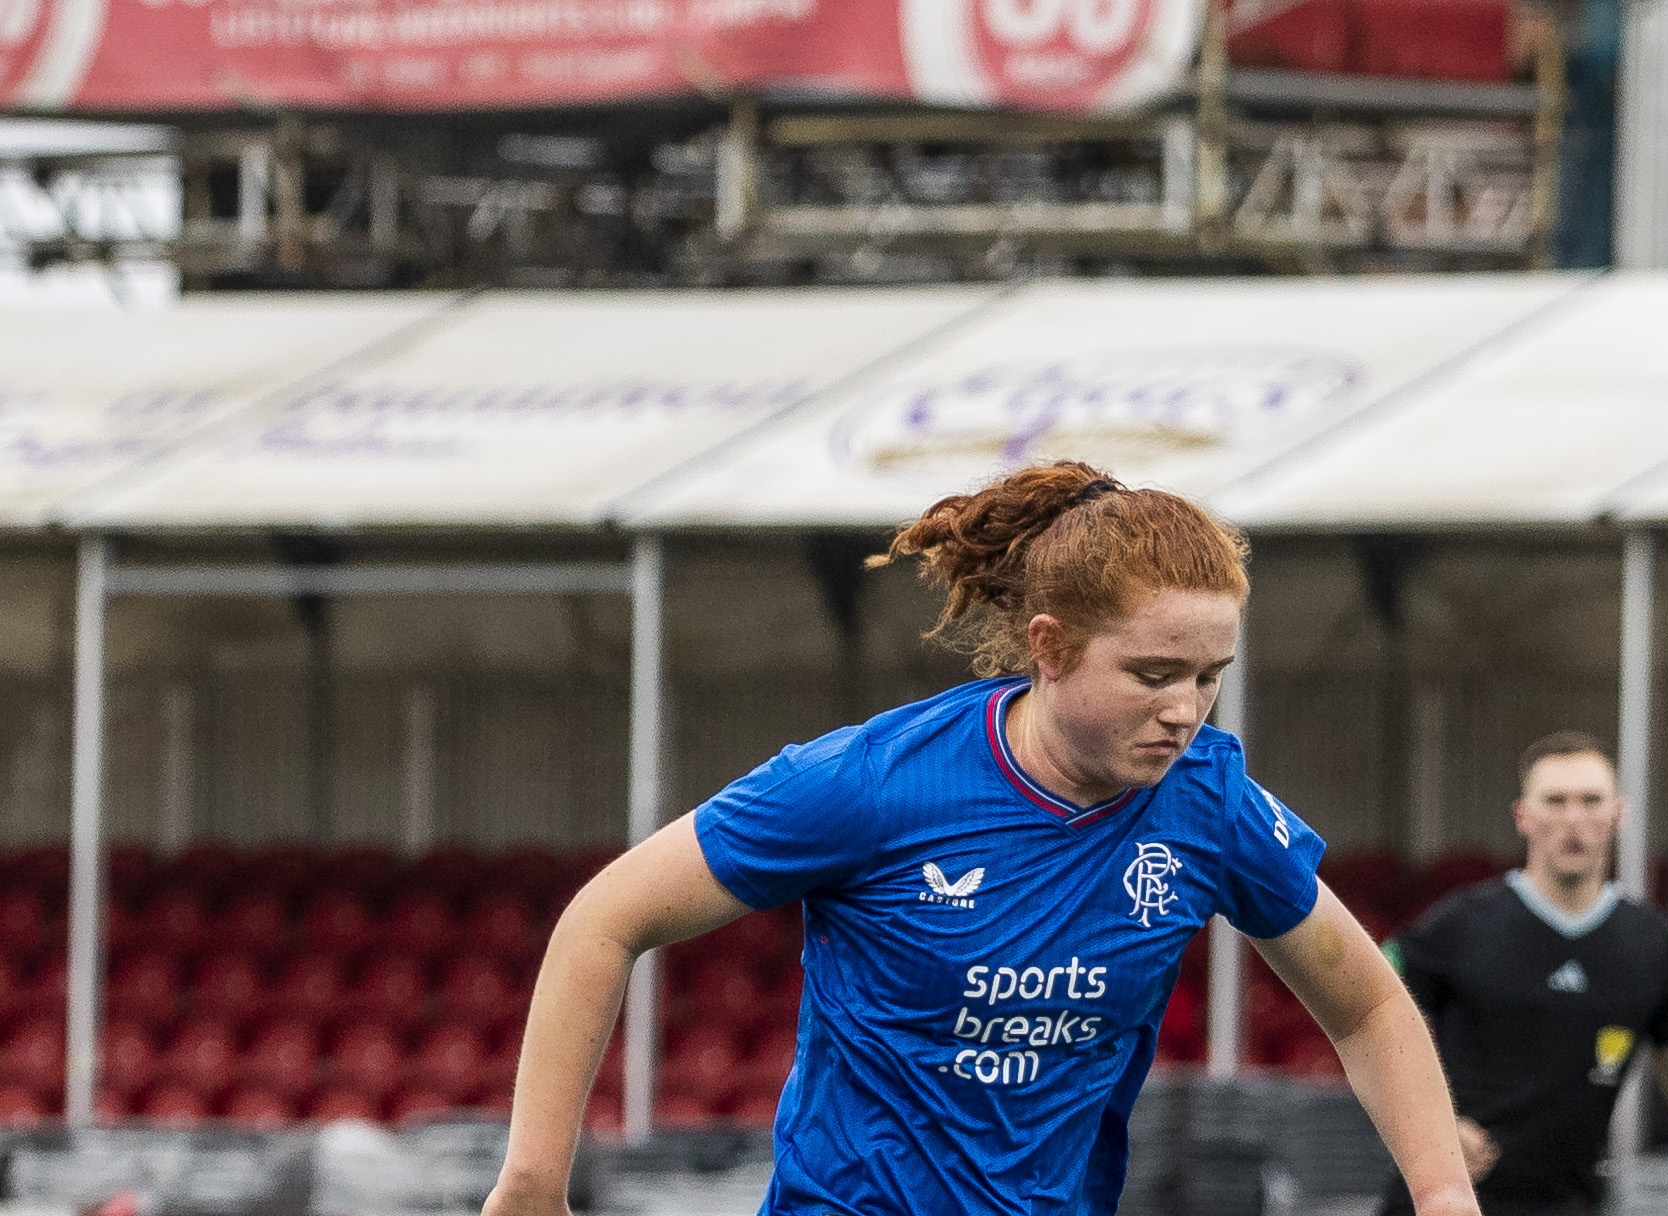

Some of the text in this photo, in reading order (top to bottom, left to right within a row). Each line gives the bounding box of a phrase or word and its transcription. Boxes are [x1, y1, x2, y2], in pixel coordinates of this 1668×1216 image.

[919, 891, 975, 909] CASTORE
[963, 956, 1107, 1006] sports
[953, 1006, 1102, 1047] breaks
